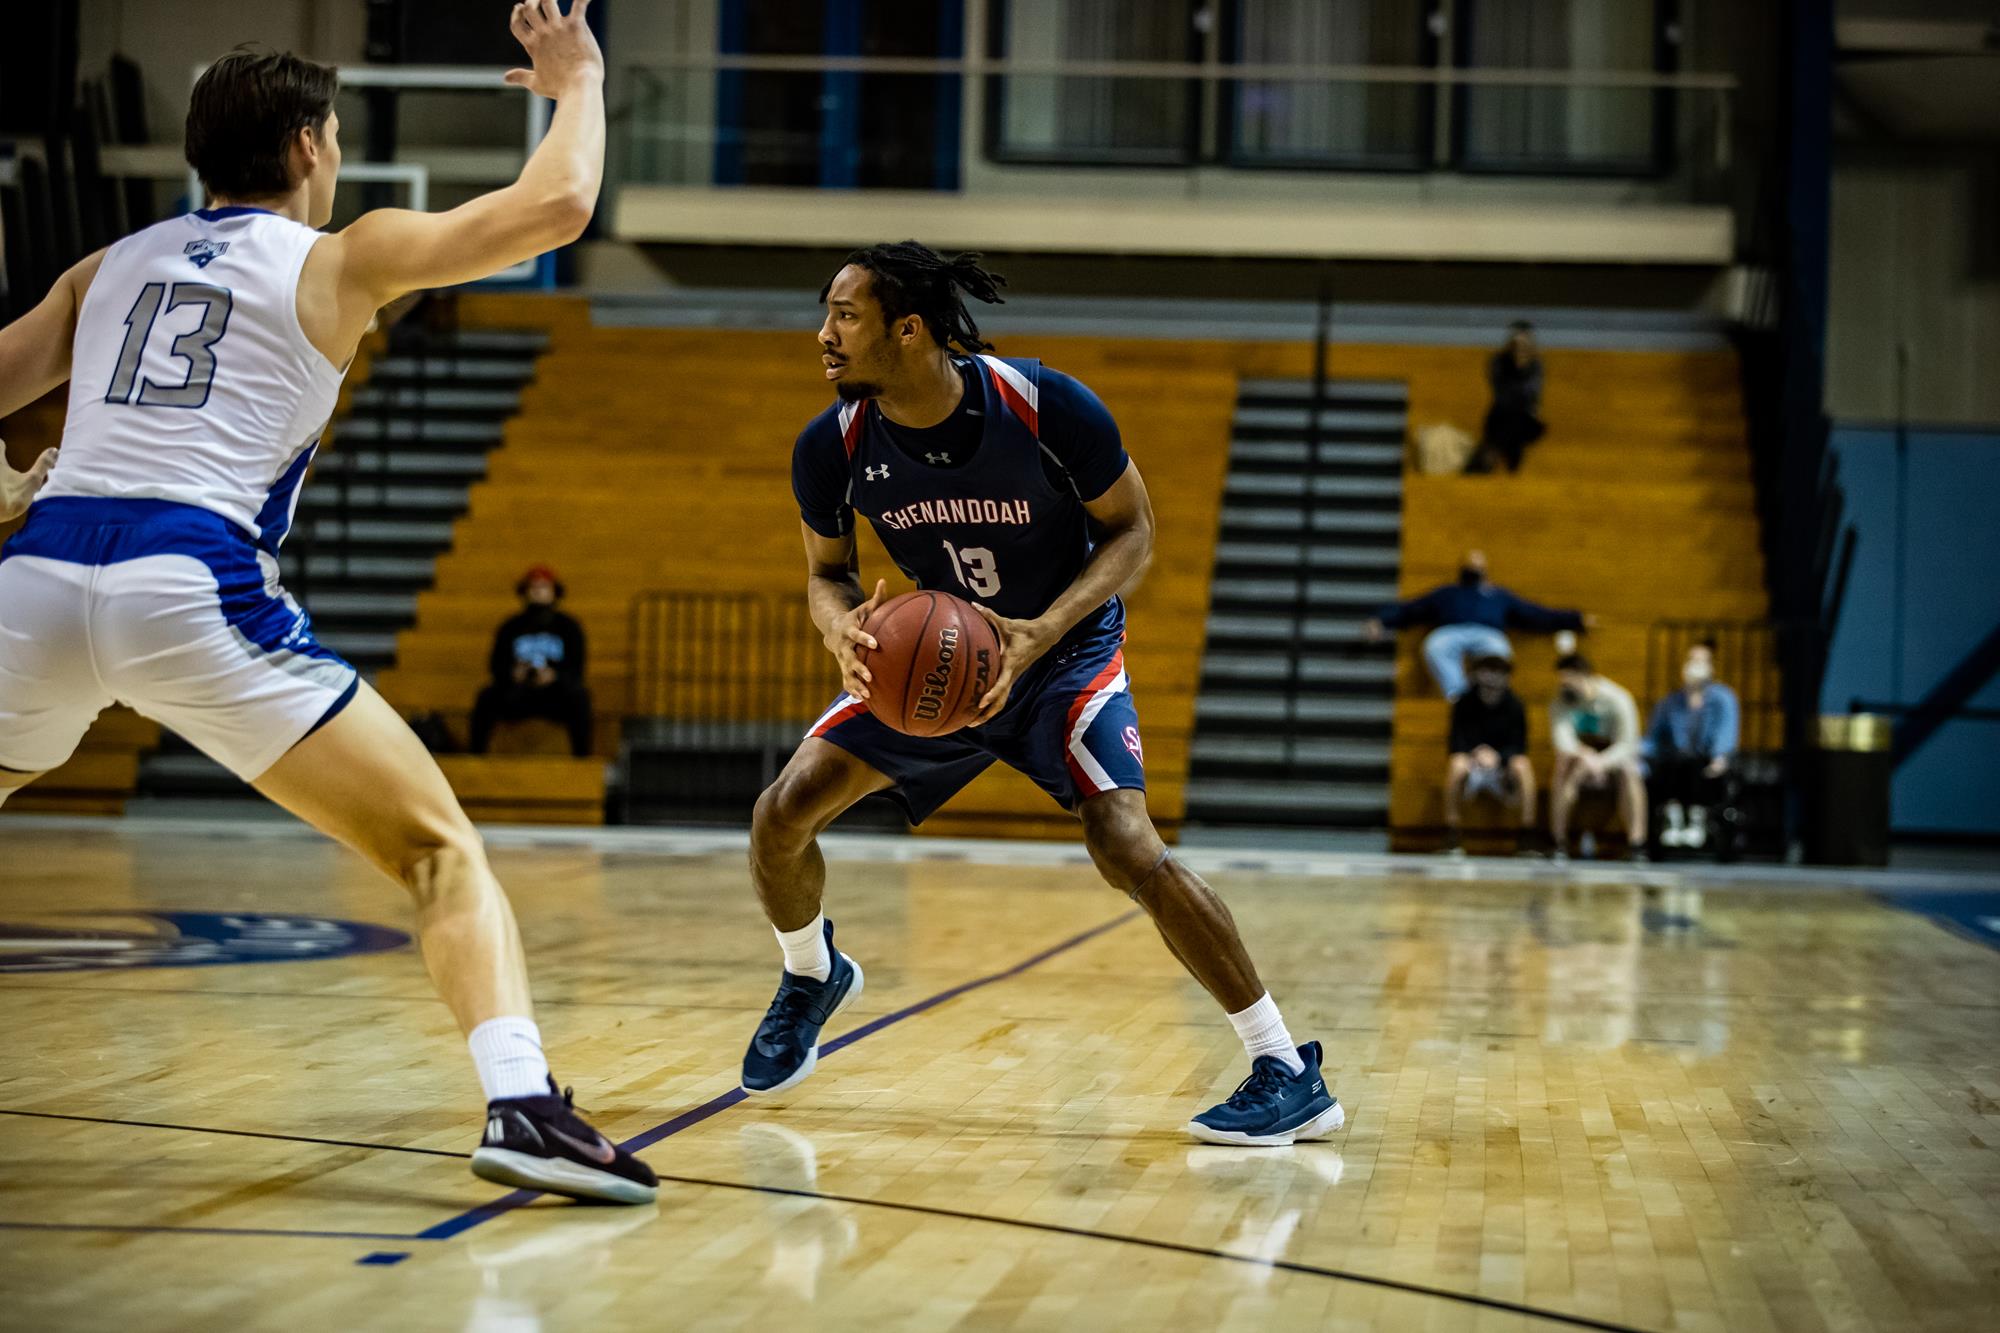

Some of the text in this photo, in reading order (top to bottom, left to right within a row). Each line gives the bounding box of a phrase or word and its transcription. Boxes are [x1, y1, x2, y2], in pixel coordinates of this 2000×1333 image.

[104, 282, 233, 408] 13
[881, 499, 1032, 530] SHENANDOAH
[943, 539, 1002, 598] 13
[912, 627, 959, 721] Wilson
